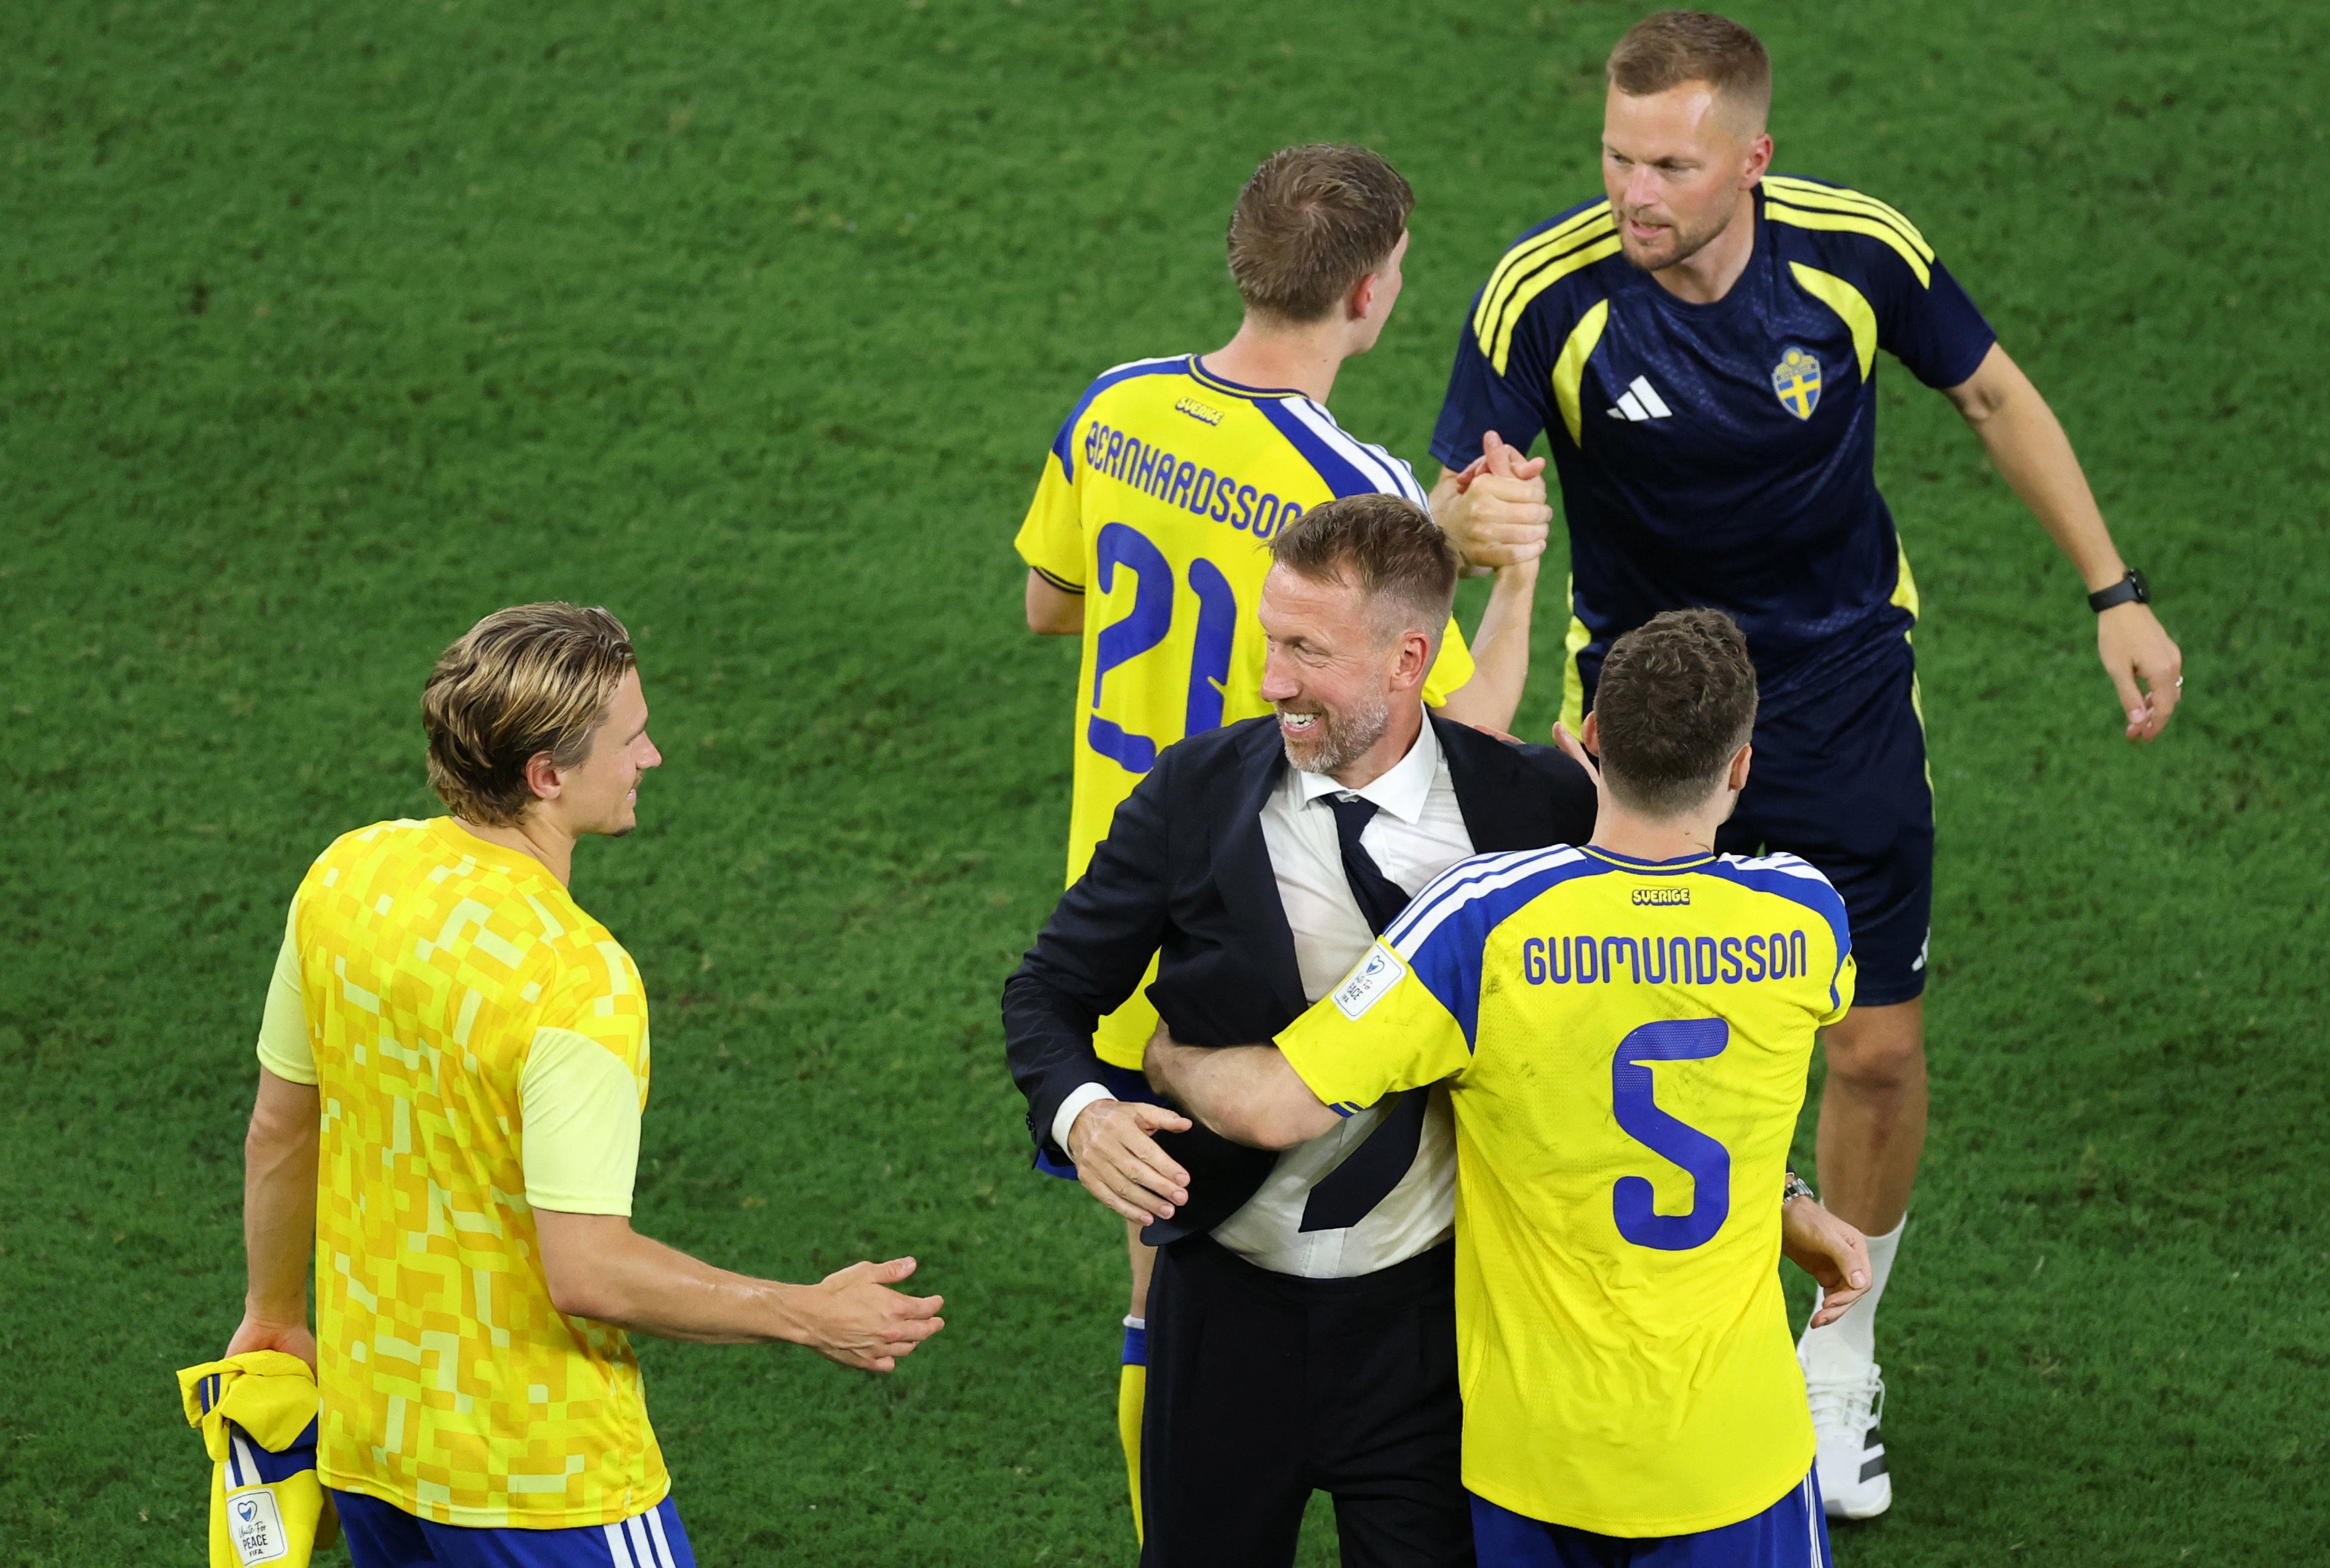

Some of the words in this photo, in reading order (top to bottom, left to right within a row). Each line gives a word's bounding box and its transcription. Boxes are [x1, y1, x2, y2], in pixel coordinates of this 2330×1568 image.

[1175, 397, 1223, 426] SVERIGE
[1088, 522, 1236, 773] 21
[1632, 888, 1690, 906] SVERIGE
[1524, 930, 1806, 985] GUDMUNDSSON
[1612, 1017, 1730, 1250] 5
[243, 1534, 268, 1550] PEACE
